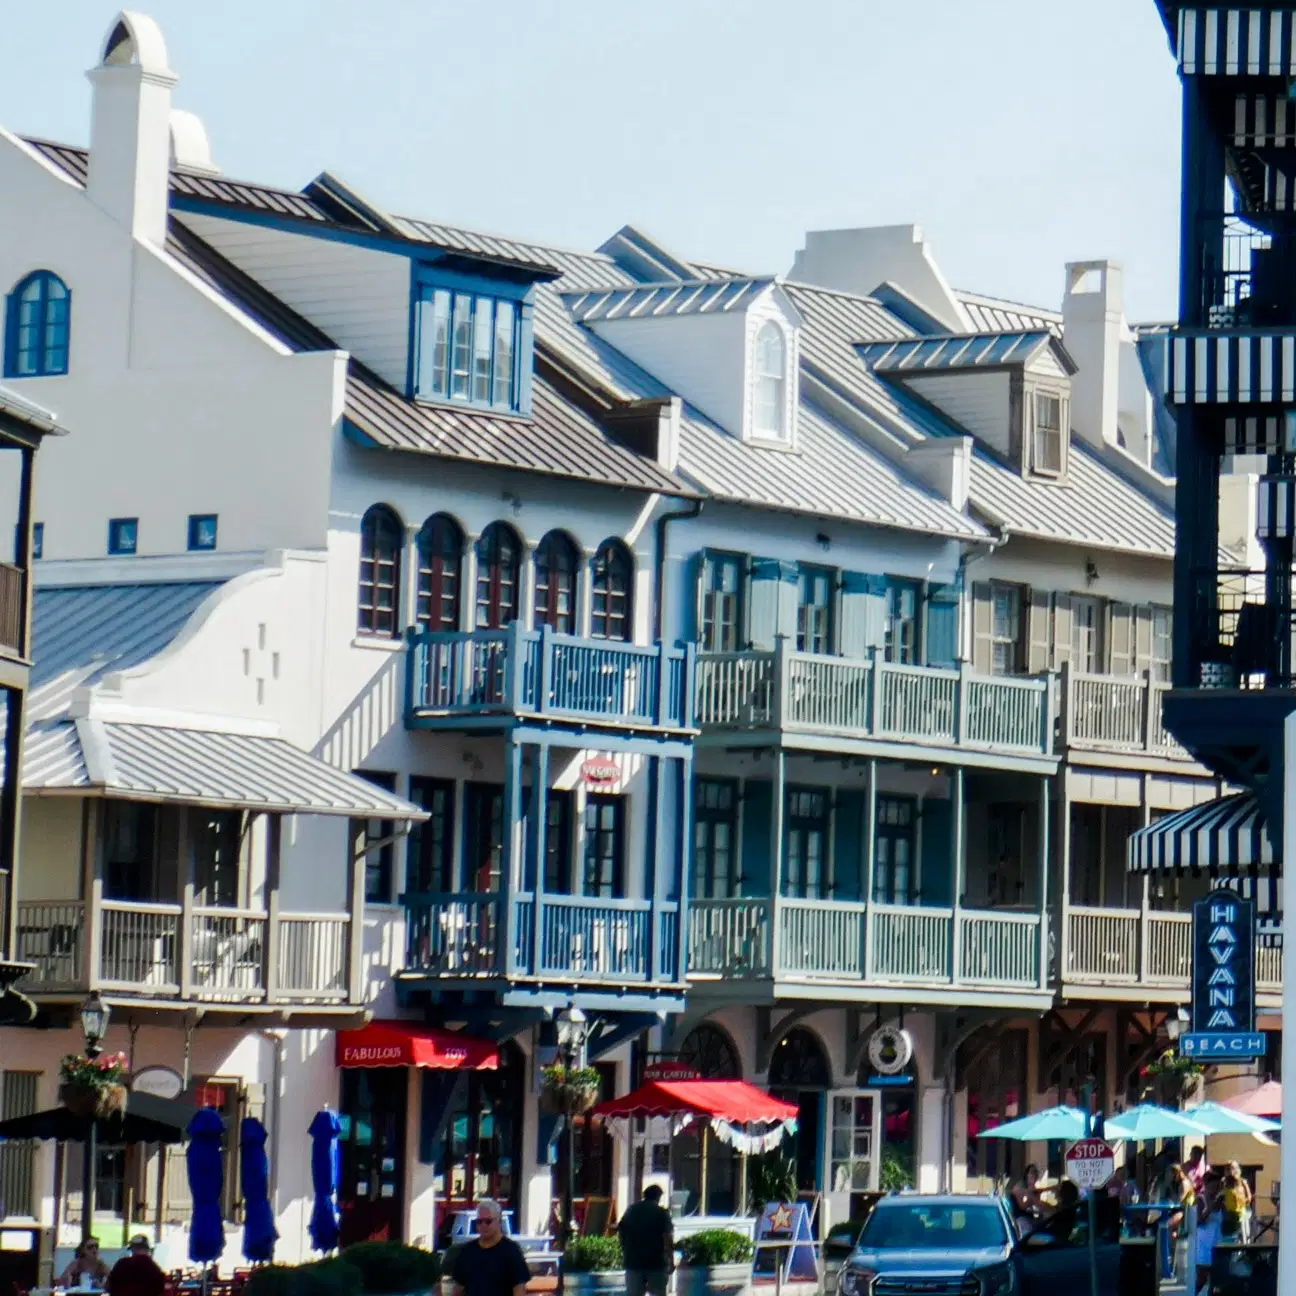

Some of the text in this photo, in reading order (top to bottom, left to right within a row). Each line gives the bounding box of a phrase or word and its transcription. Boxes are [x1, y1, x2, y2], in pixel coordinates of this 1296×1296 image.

[1207, 904, 1236, 1028] HAVANA
[1184, 1038, 1261, 1050] BEACH
[344, 1046, 401, 1061] FABULOUS
[1075, 1144, 1105, 1158] STOP
[1089, 1160, 1104, 1168] NOT
